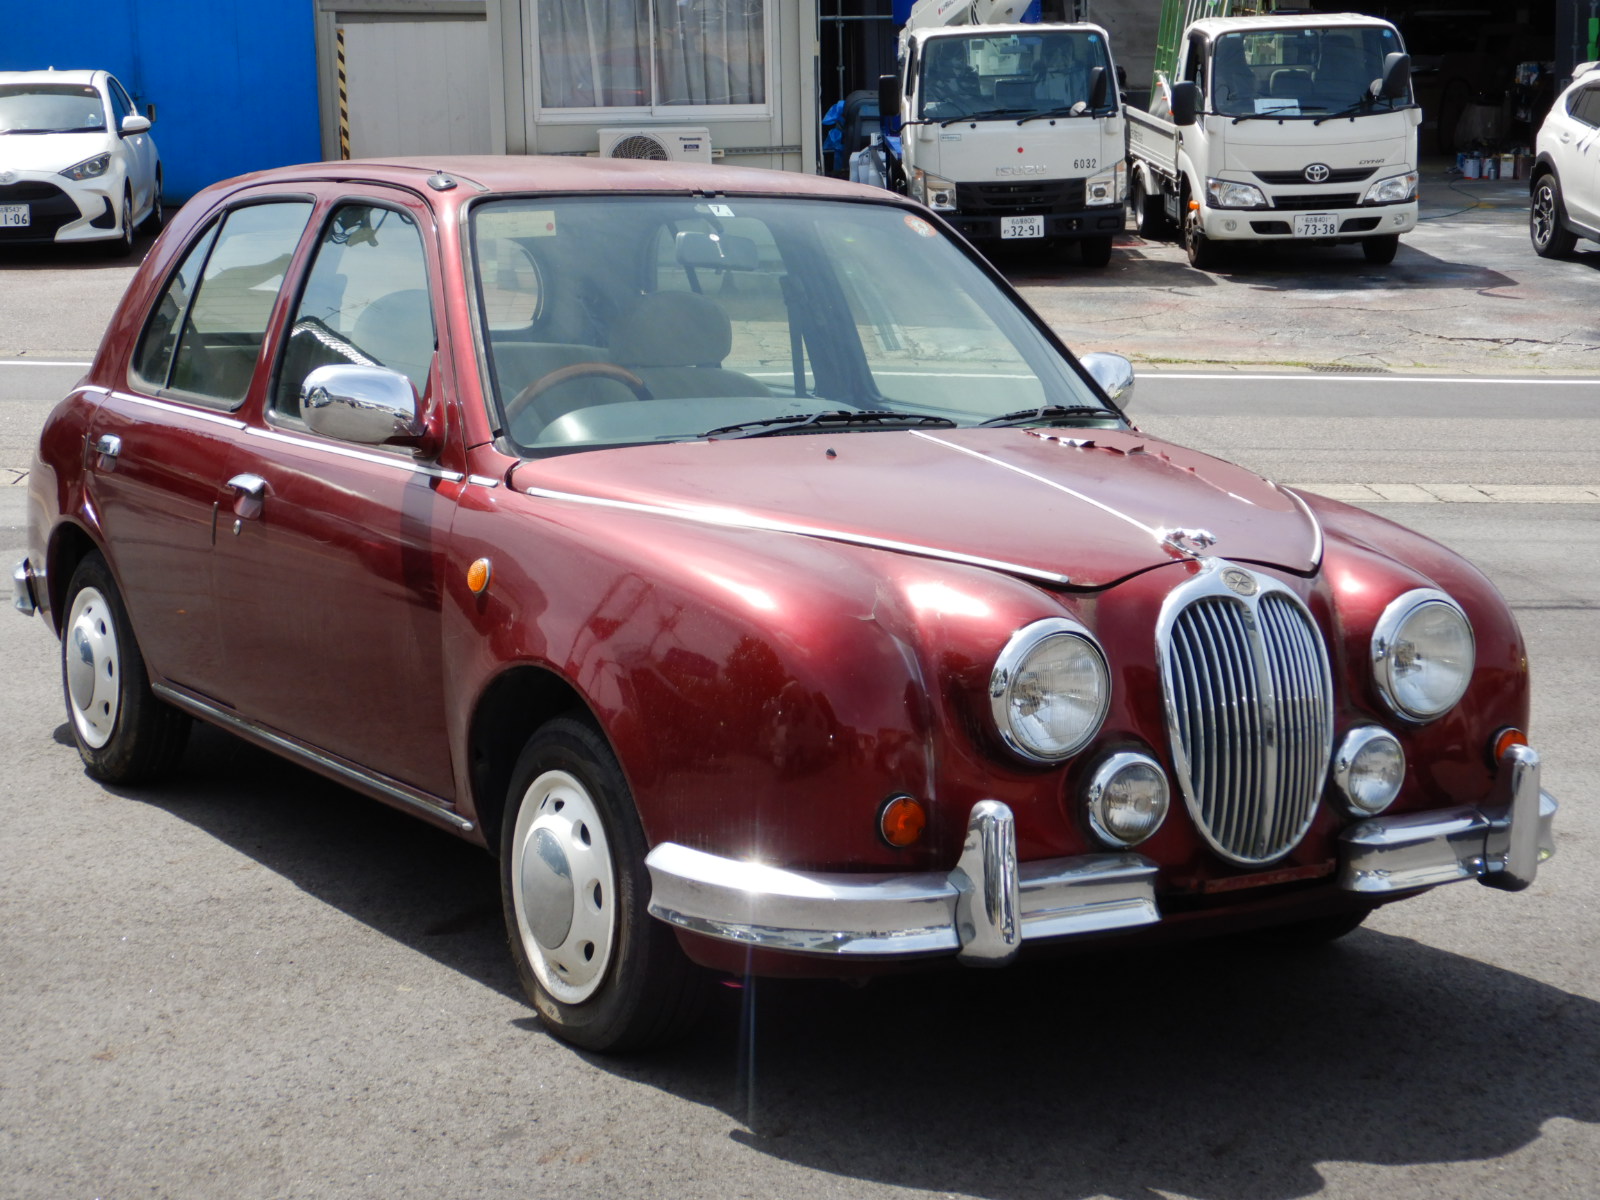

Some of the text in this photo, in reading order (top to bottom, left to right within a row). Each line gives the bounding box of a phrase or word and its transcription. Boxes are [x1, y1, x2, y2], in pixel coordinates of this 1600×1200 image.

[1073, 159, 1097, 169] 6032
[996, 165, 1047, 176] ISUZU
[1011, 224, 1041, 237] 32-91
[1304, 223, 1335, 236] 73-38
